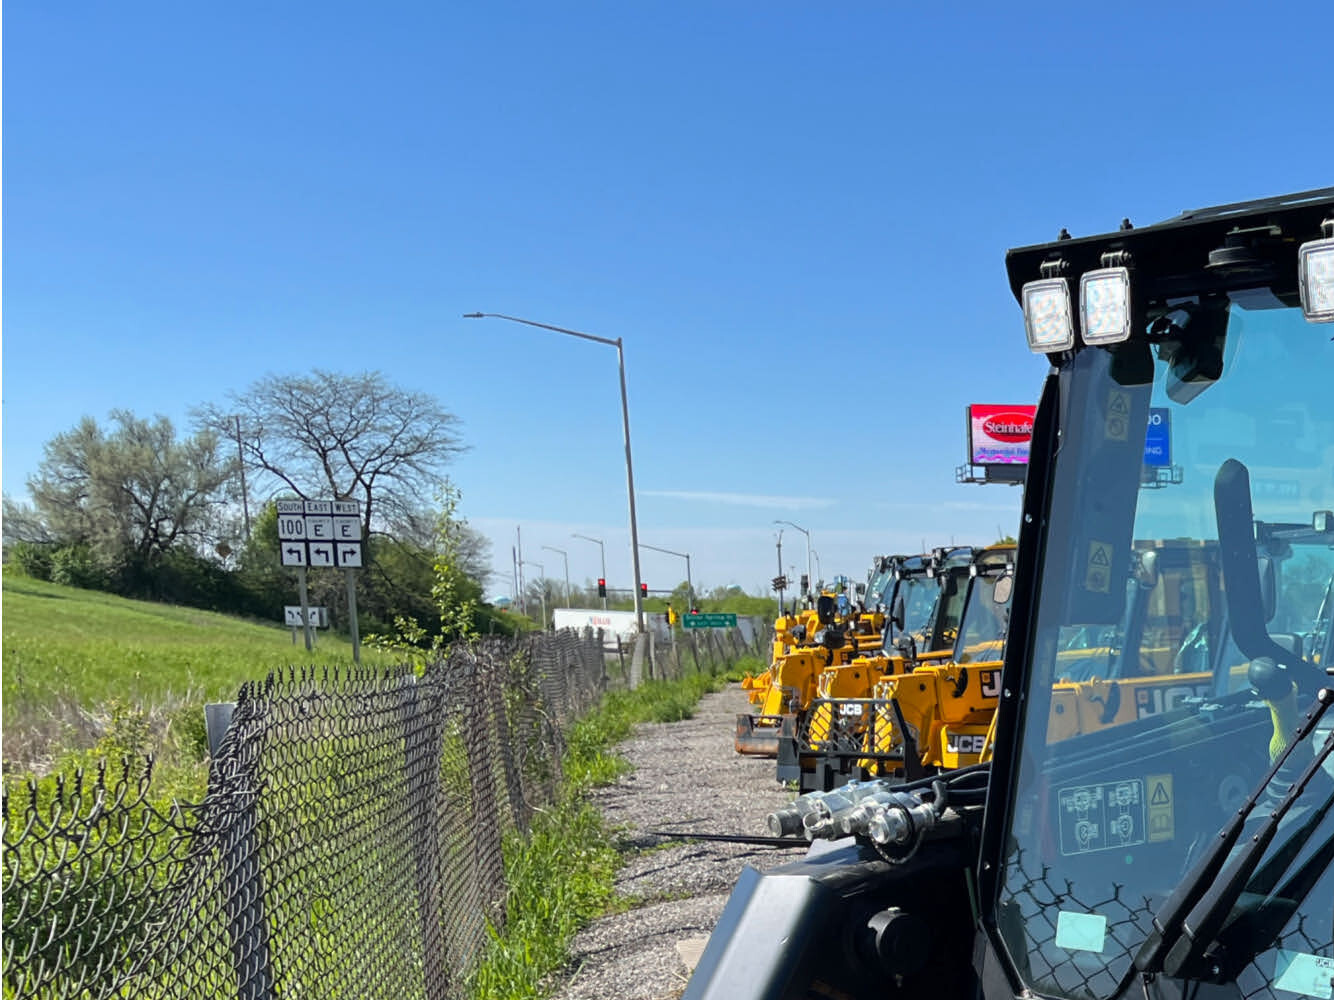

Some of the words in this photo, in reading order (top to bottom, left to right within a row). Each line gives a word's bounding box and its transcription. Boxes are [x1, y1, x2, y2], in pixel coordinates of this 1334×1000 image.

[307, 503, 328, 512] EAST
[335, 503, 356, 512] WEST
[281, 519, 303, 535] 100
[314, 524, 324, 537] E
[341, 525, 352, 537] E
[839, 703, 863, 716] JCB
[947, 735, 985, 753] JCB
